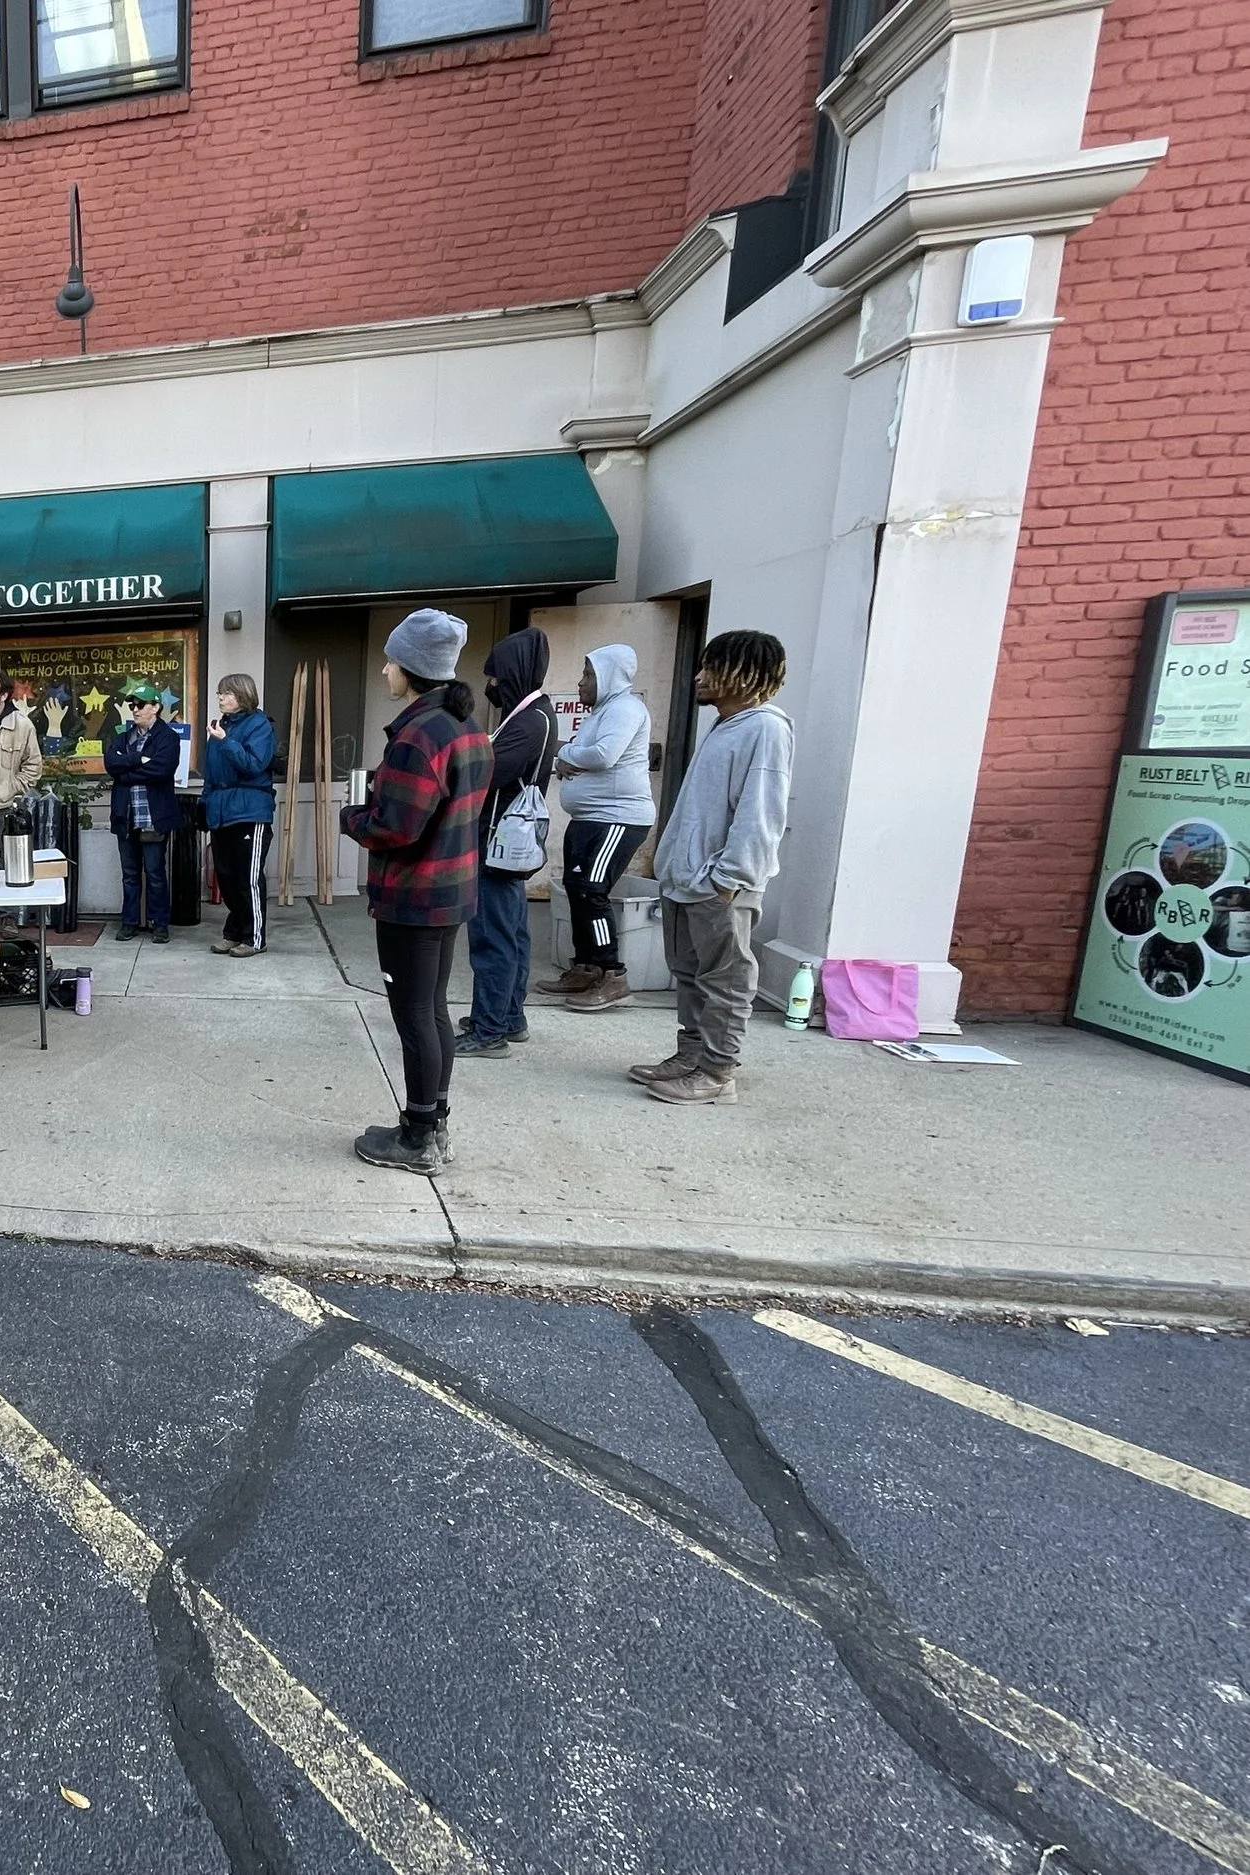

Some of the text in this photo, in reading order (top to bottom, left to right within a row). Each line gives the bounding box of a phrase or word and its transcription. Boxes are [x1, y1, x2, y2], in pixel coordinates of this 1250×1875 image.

[20, 646, 163, 664] WELCOME TO OUR SCHOOL
[6, 660, 179, 677] WHERE NO CHILD IS LEFT BEHIND
[1165, 659, 1229, 677] Food
[555, 701, 591, 714] EMER
[1139, 767, 1173, 780] RUST
[1175, 768, 1210, 782] BELT
[1127, 789, 1147, 798] Food
[1148, 791, 1172, 801] Scrap
[1173, 793, 1225, 806] Composting
